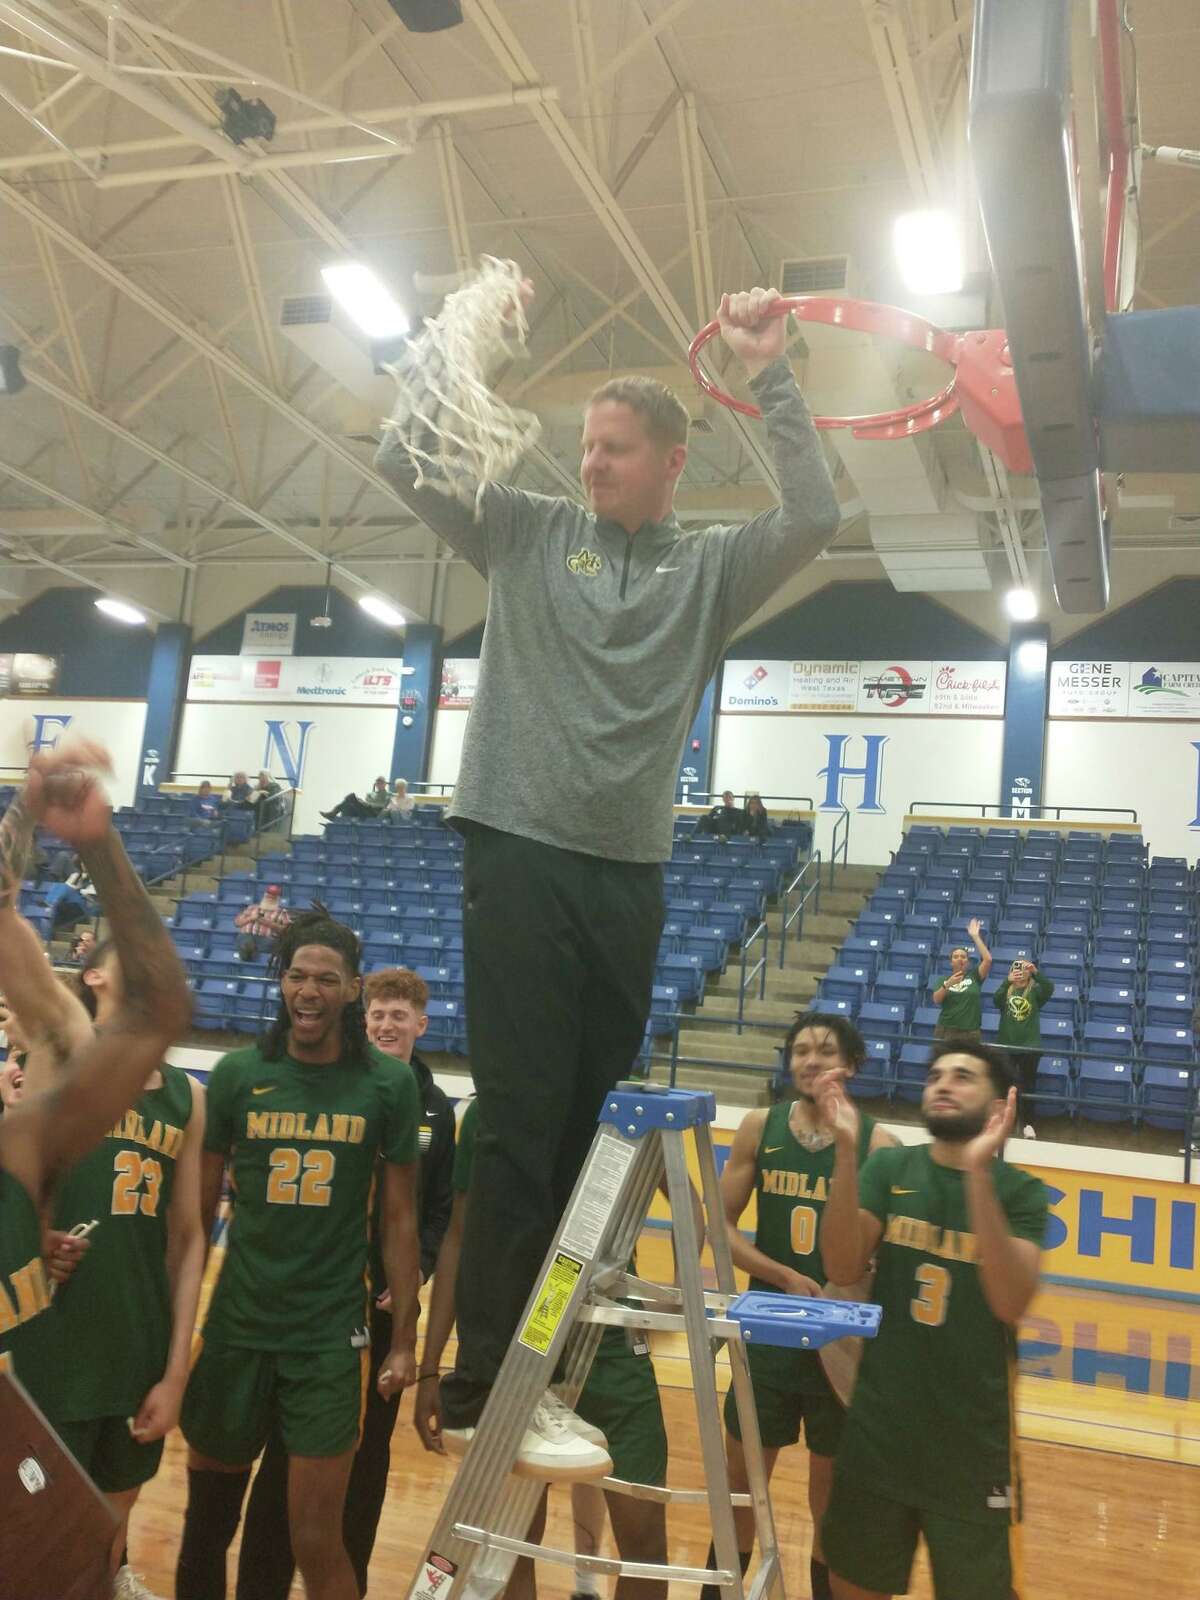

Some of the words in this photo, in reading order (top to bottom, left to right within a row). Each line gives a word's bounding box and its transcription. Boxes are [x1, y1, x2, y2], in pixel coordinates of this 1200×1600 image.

[793, 662, 859, 676] Dynamic
[1058, 677, 1121, 687] MESSER
[1069, 663, 1112, 674] GENE
[297, 686, 347, 696] Medtronic
[728, 696, 778, 706] Domino's
[264, 720, 318, 788] N
[143, 765, 157, 785] K
[816, 734, 889, 813] H
[1011, 796, 1031, 819] M
[247, 1111, 367, 1144] MIDLAND
[111, 1150, 163, 1217] 23
[267, 1148, 336, 1207] 22
[762, 1169, 833, 1201] MIDLA
[790, 1205, 817, 1256] 0
[910, 1262, 952, 1327] 3
